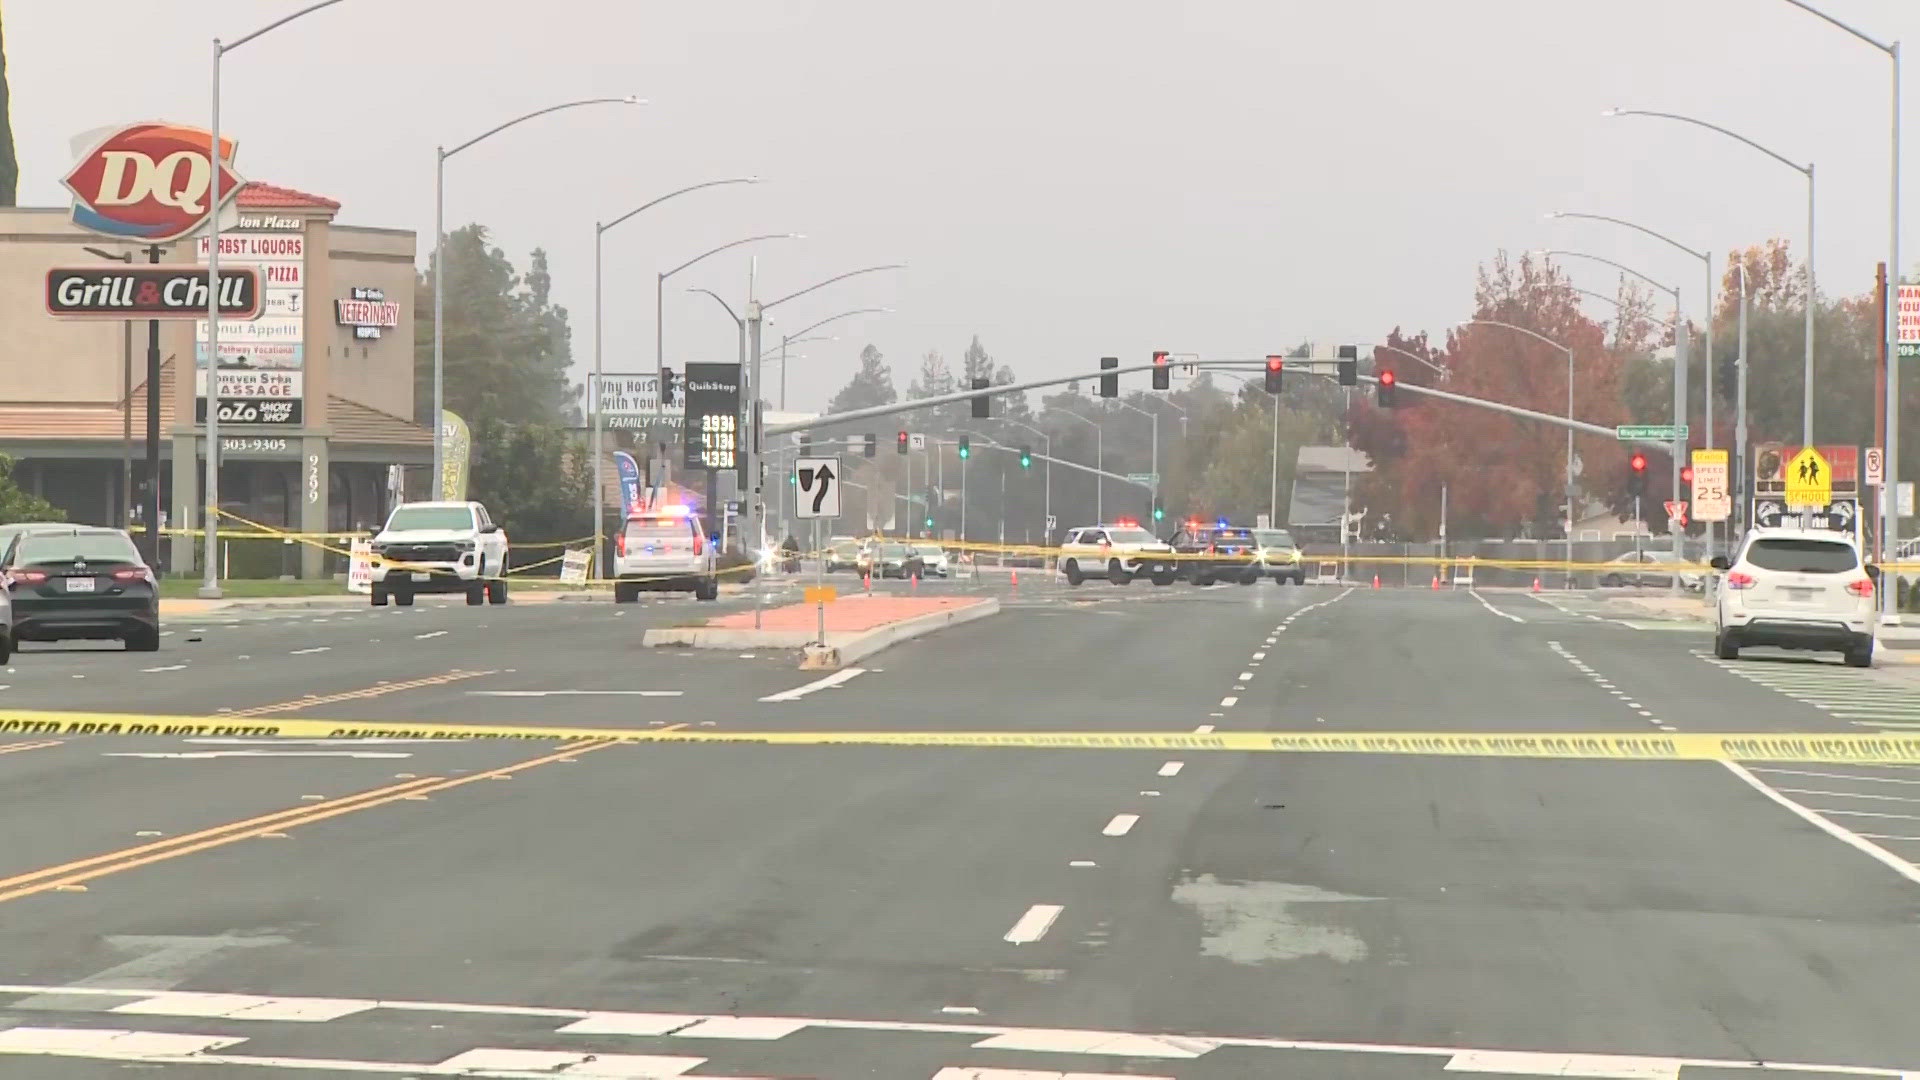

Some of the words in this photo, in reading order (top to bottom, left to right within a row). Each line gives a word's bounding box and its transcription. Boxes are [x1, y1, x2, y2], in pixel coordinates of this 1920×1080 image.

[95, 151, 213, 214] DQ
[240, 216, 261, 229] ton
[264, 215, 300, 229] Plaza
[201, 238, 248, 254] HRBST
[251, 238, 302, 254] LIQUORS
[267, 266, 299, 282] PIZZA
[57, 276, 136, 307] Grill
[139, 280, 161, 306] &
[340, 302, 398, 325] VETERINARY
[201, 323, 242, 335] Dnut
[247, 323, 297, 337] Appetit
[219, 385, 292, 396] ASSAGE
[216, 402, 257, 421] oZo
[609, 417, 648, 429] FAMILY
[1697, 487, 1723, 500] 25
[1789, 492, 1826, 502] SCHOOL
